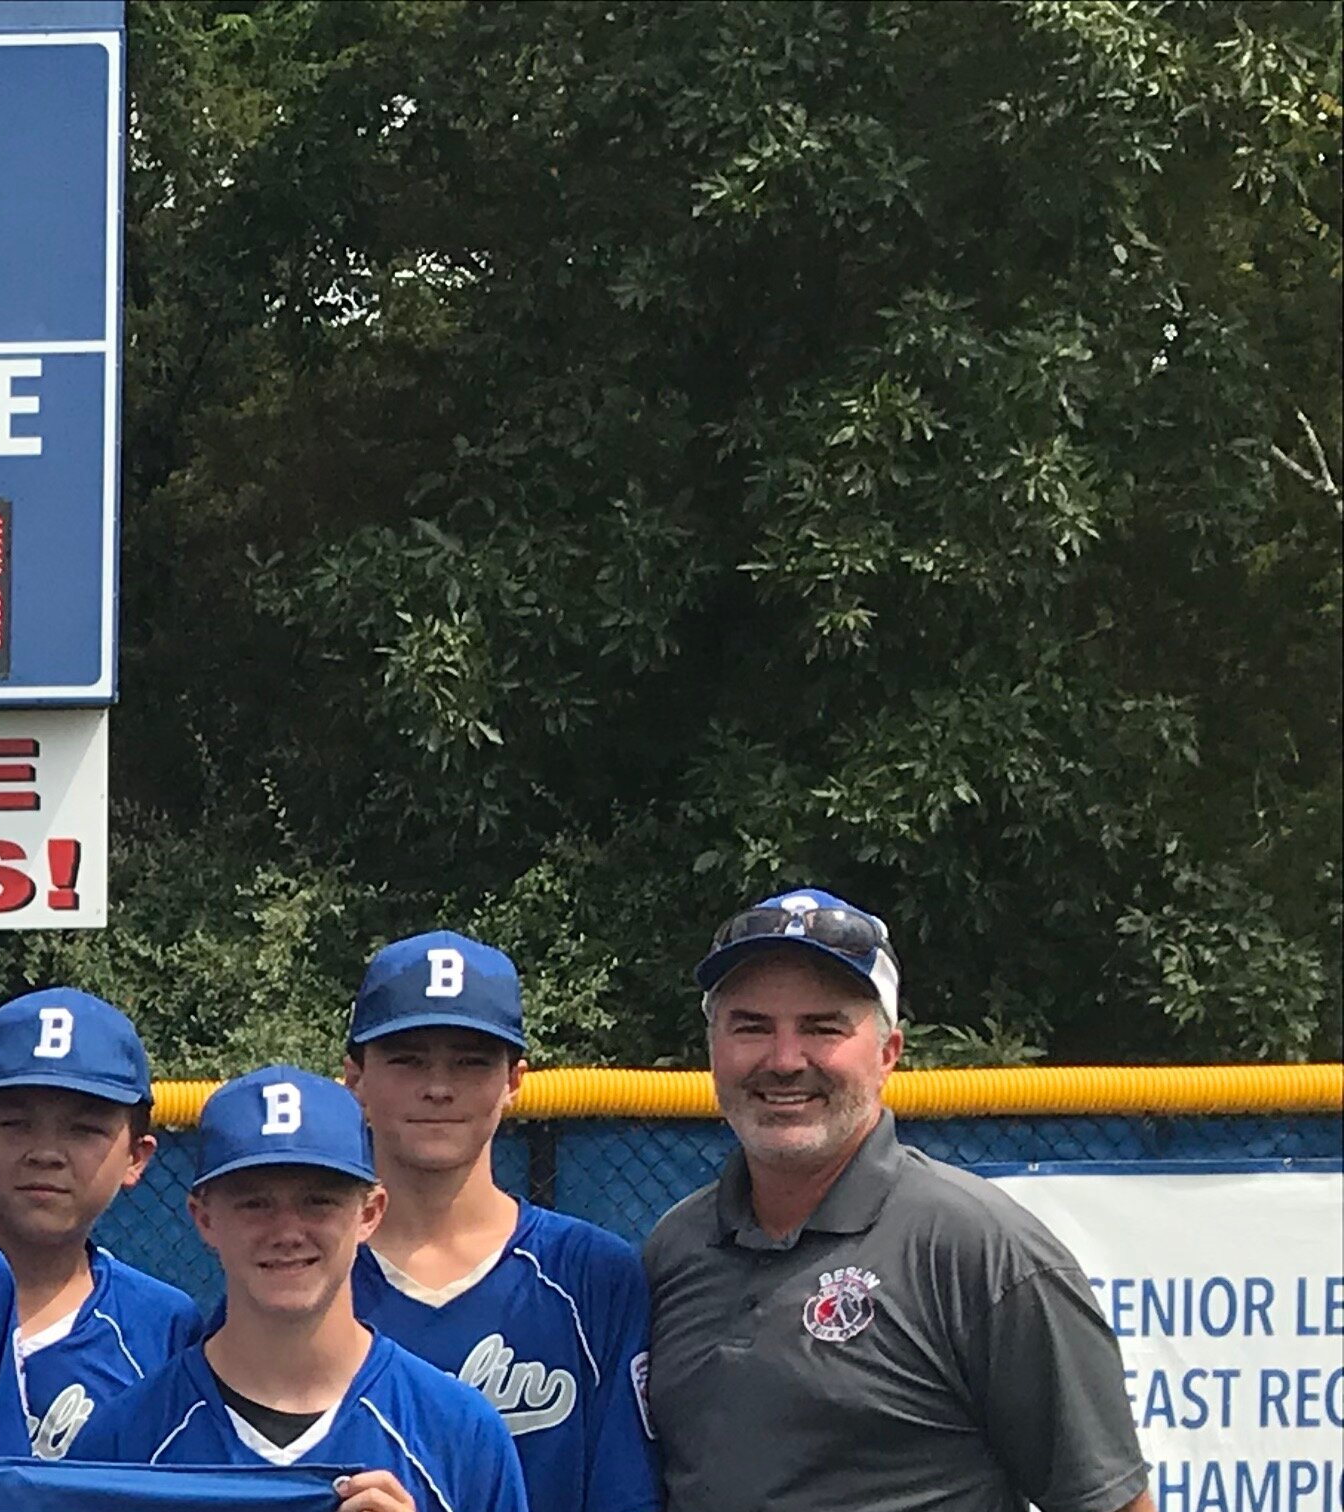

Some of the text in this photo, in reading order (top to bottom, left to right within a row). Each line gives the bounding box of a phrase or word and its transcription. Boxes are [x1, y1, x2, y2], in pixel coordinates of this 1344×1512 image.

[425, 947, 465, 999] B
[33, 1007, 75, 1059] B
[260, 1081, 302, 1136] B
